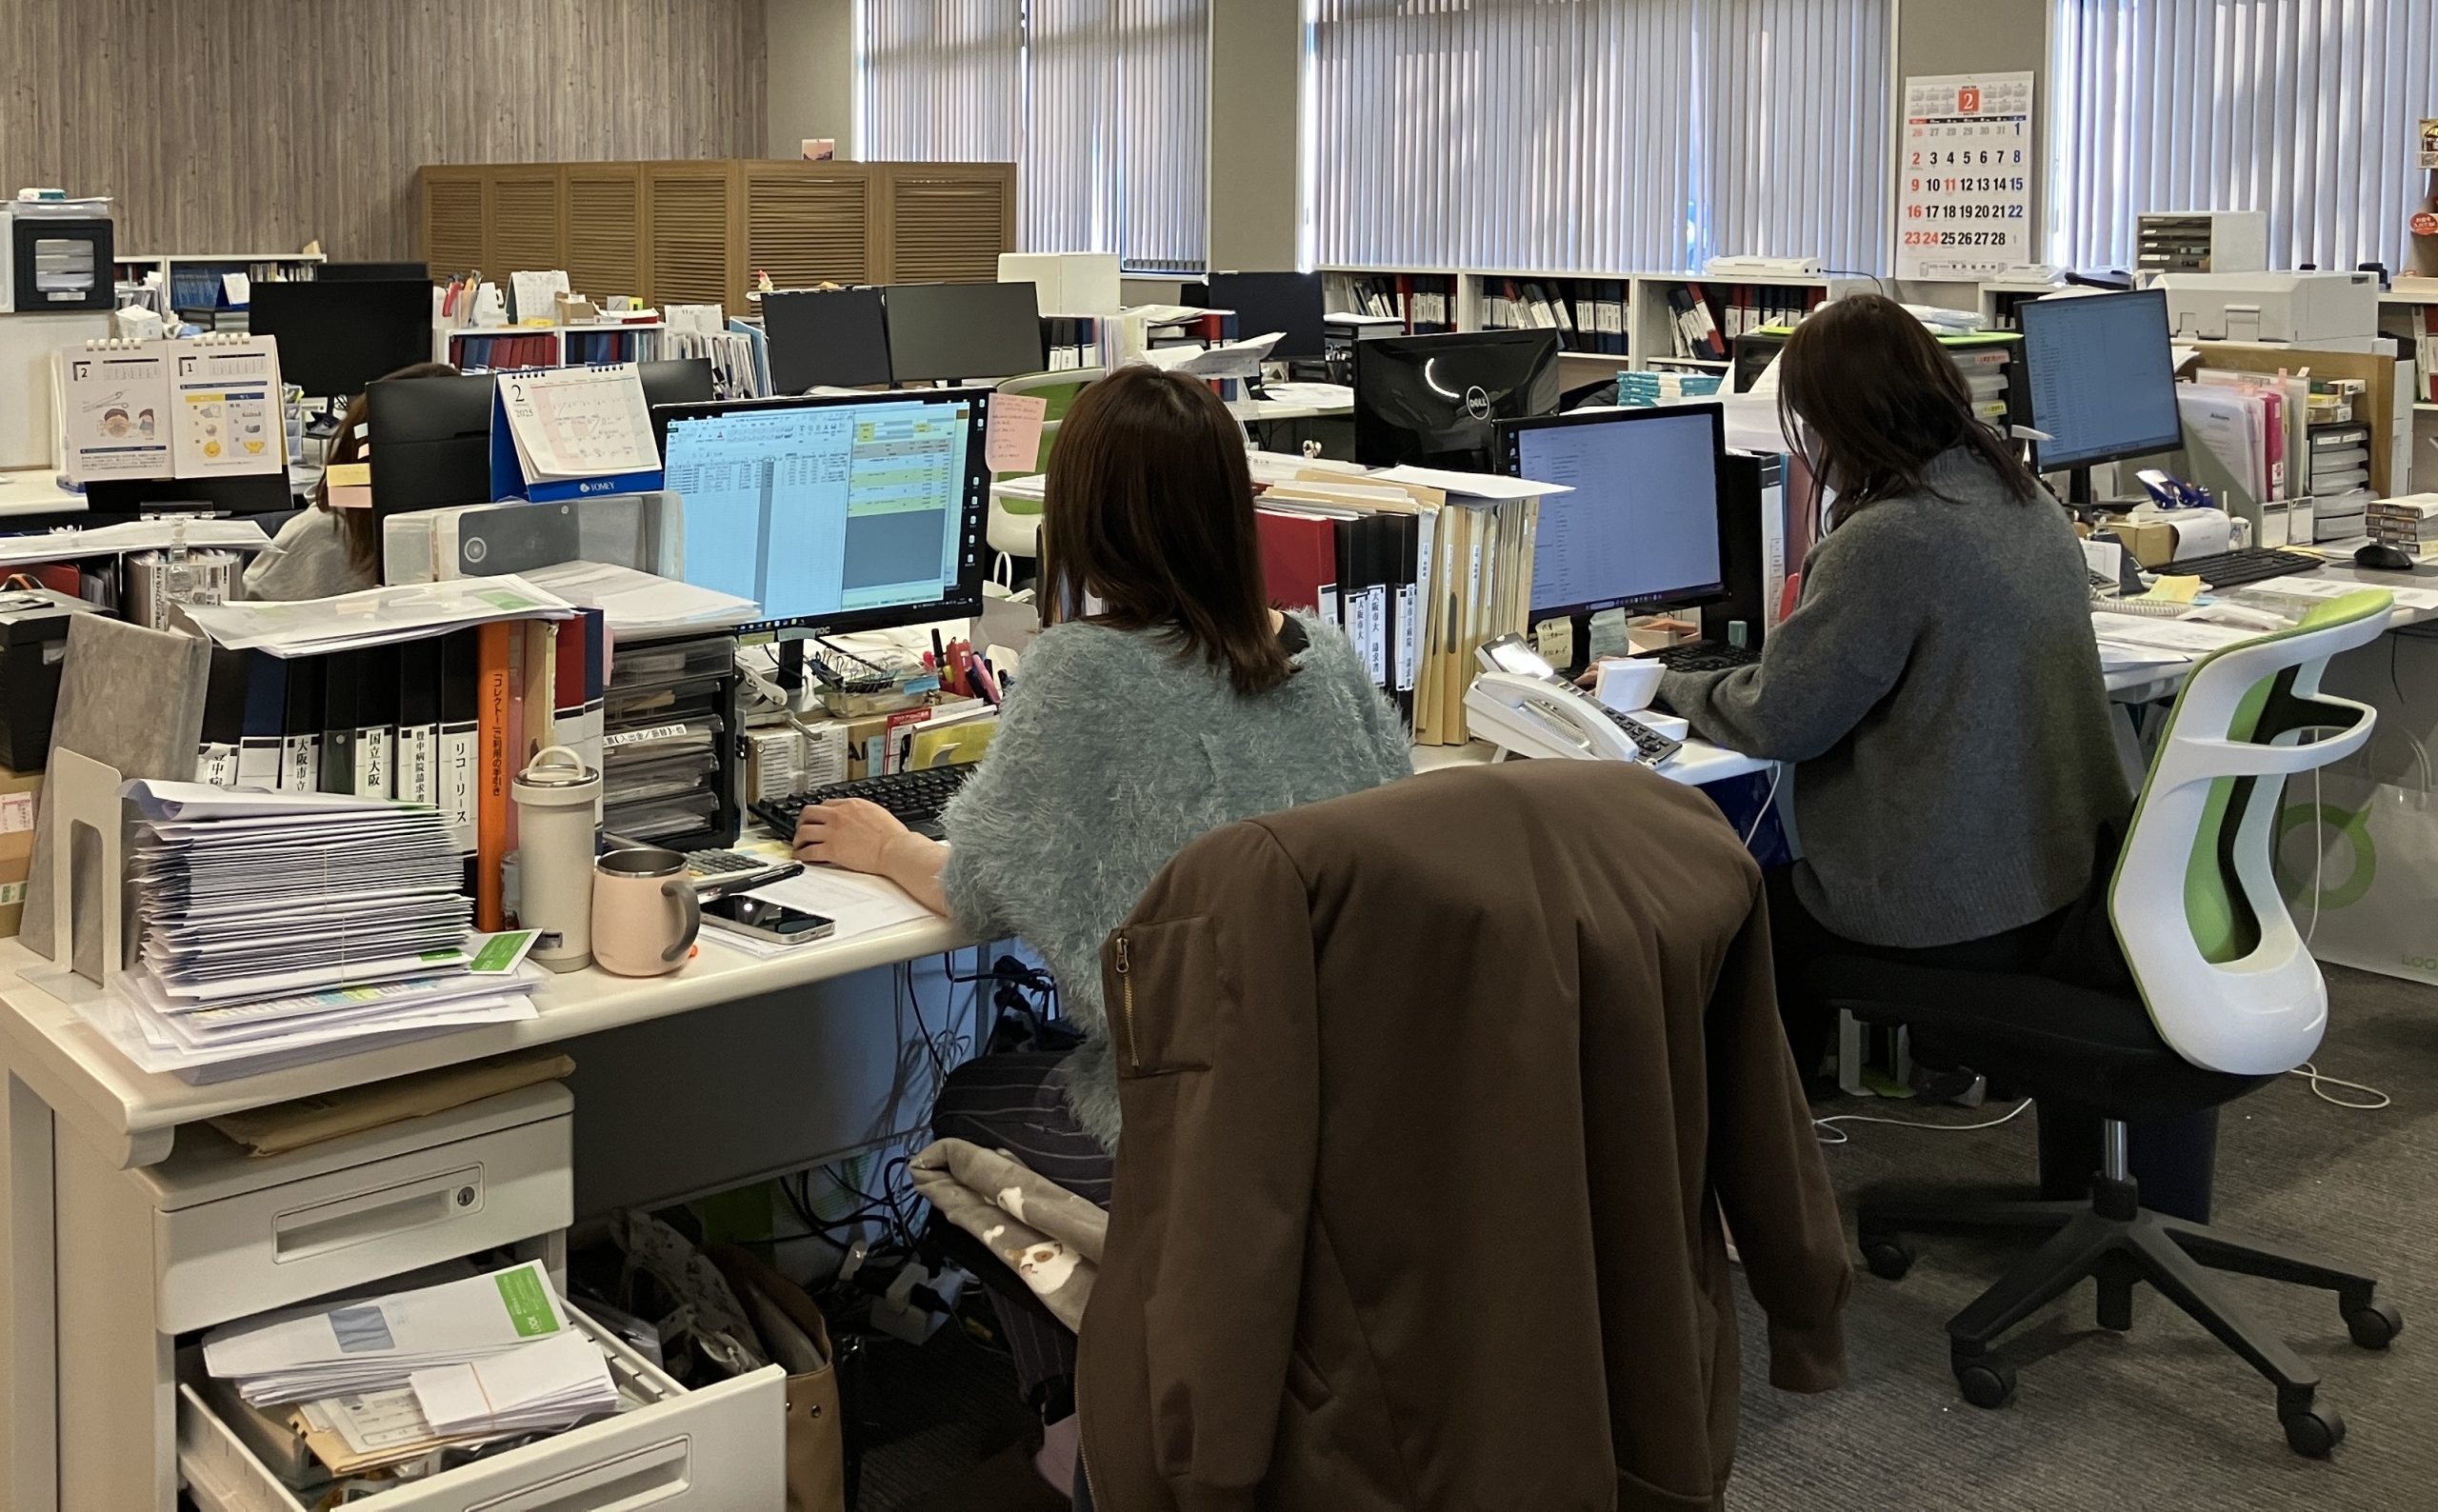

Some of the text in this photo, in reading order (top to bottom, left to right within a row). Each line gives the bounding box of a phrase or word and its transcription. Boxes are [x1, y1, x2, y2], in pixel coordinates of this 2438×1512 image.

[1964, 93, 1973, 109] 2
[2014, 123, 2020, 135] 1
[1912, 150, 2021, 165] 2 3 4 5 6 7 8
[1911, 178, 2023, 191] 9 10 11 12 13 14 15
[1908, 206, 2023, 218] 16 17 18 19 20 21 22
[1905, 232, 2006, 245] 23 24 25 26 27 28
[81, 368, 88, 377] 2
[187, 363, 192, 372] 1
[511, 384, 525, 402] 2
[1469, 398, 1488, 408] DELL
[515, 409, 533, 418] 2025
[590, 482, 614, 491] TOMEY
[296, 737, 309, 791] 大阪市立
[368, 732, 381, 787] 国立大阪
[455, 742, 467, 824] リコーリース
